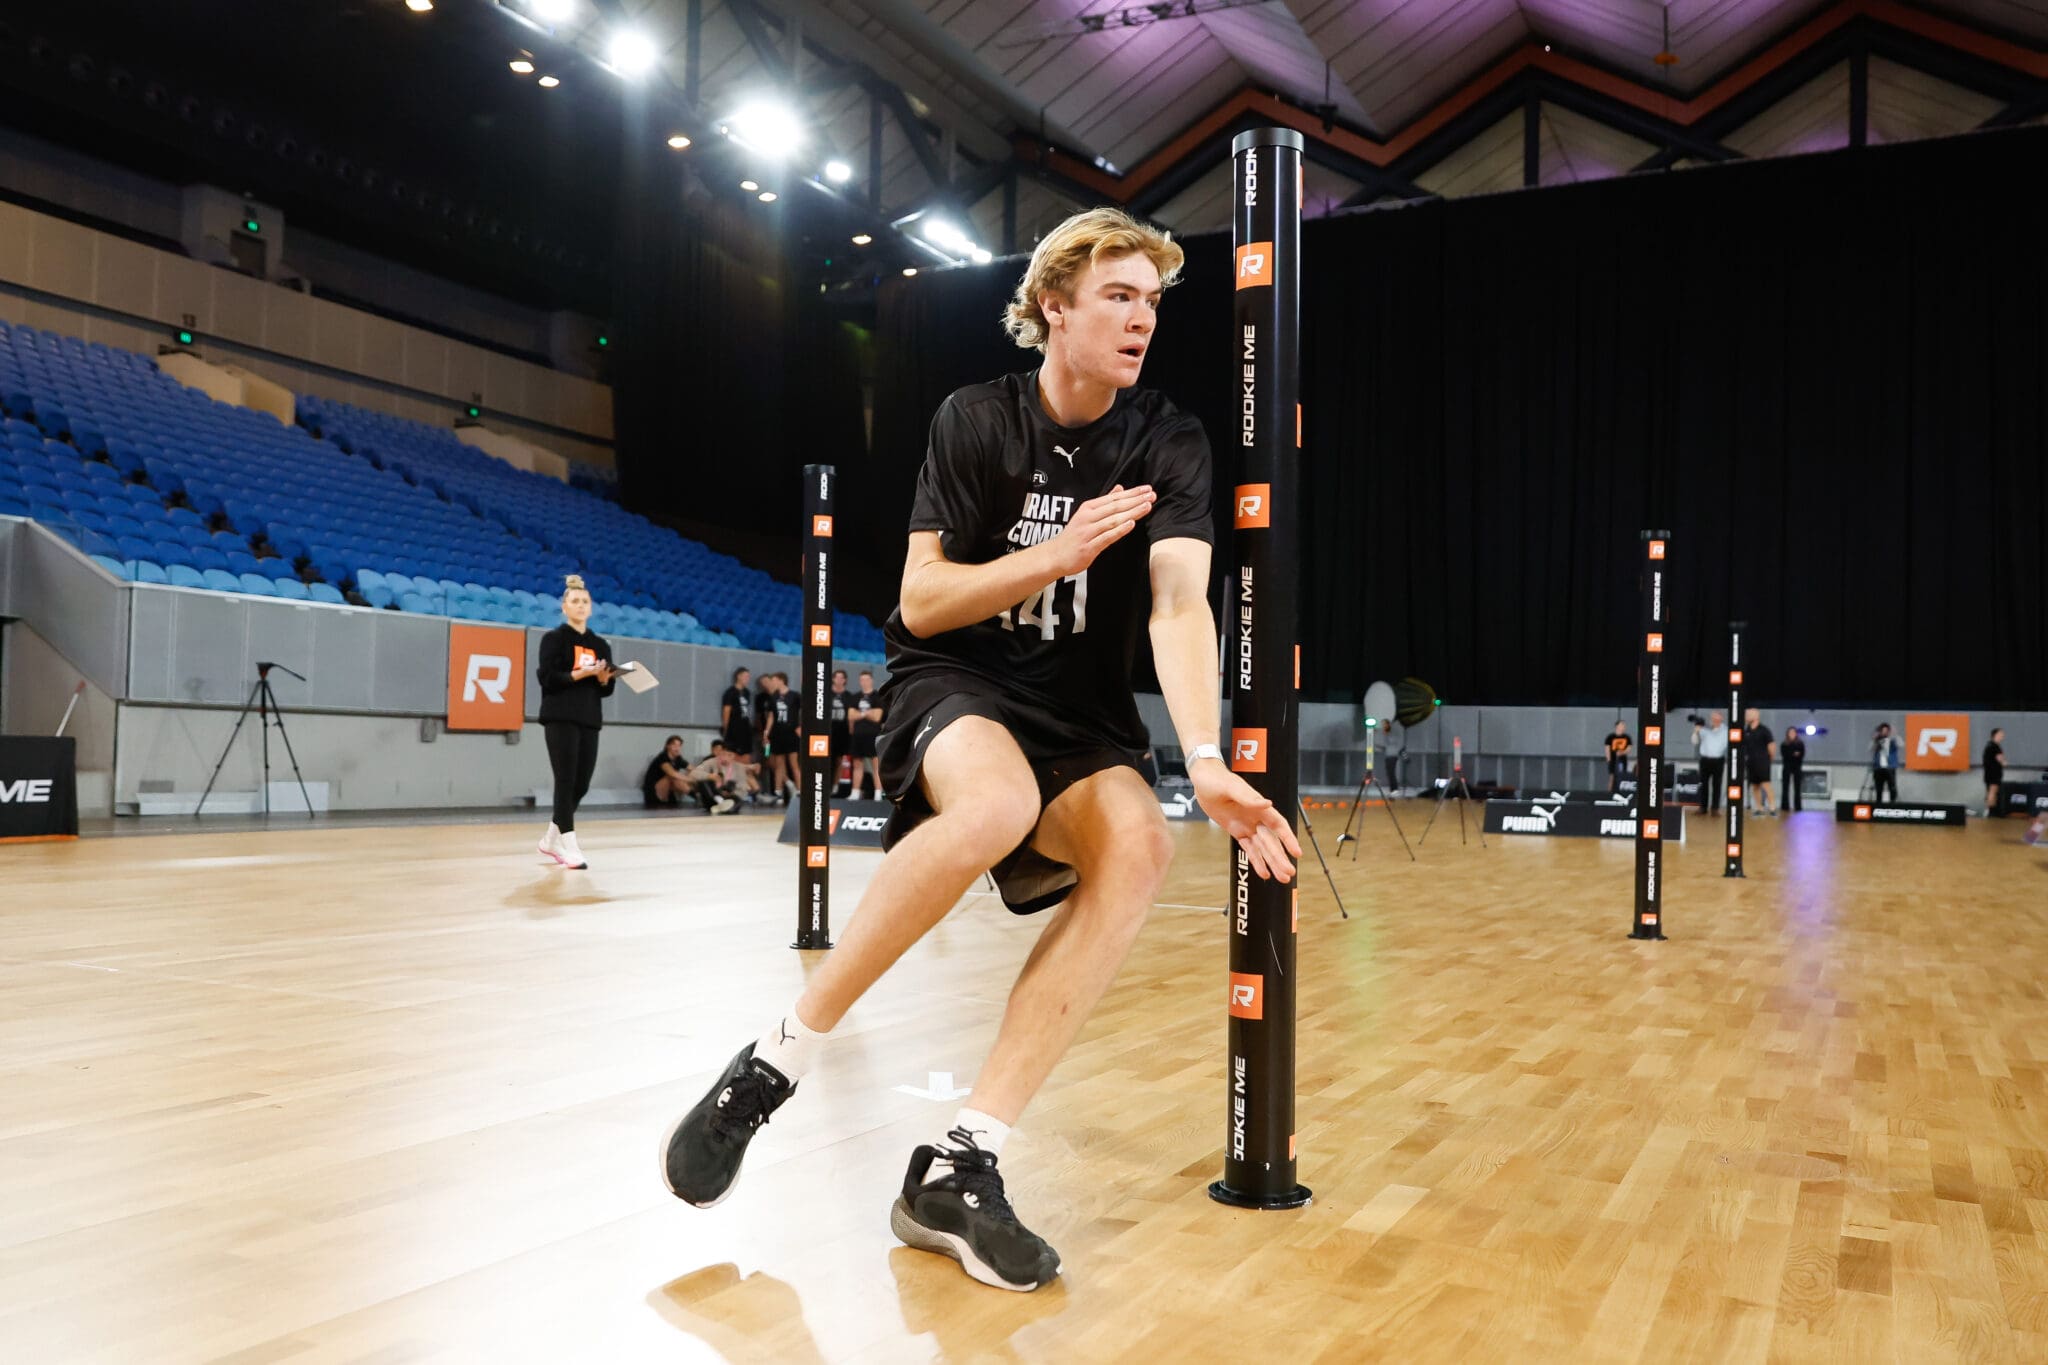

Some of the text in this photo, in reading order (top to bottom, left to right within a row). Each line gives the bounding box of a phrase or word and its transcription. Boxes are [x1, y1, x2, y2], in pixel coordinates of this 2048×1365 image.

[1242, 324, 1256, 447] ROOKIE ME
[1022, 492, 1074, 522] RAFT
[1239, 495, 1262, 518] R
[819, 552, 827, 610] ROOKIE ME
[1240, 566, 1253, 691] ROOKIE ME
[463, 654, 512, 703] R
[816, 662, 825, 720] ROOKIE ME
[1235, 739, 1259, 761] R
[1916, 728, 1958, 757] R
[0, 779, 53, 803] ME
[815, 773, 823, 830] ROOKIE ME
[1502, 816, 1549, 832] PUMA
[1237, 850, 1249, 936] ROOKIE
[1232, 984, 1255, 1008] R
[1234, 1055, 1246, 1094] ME
